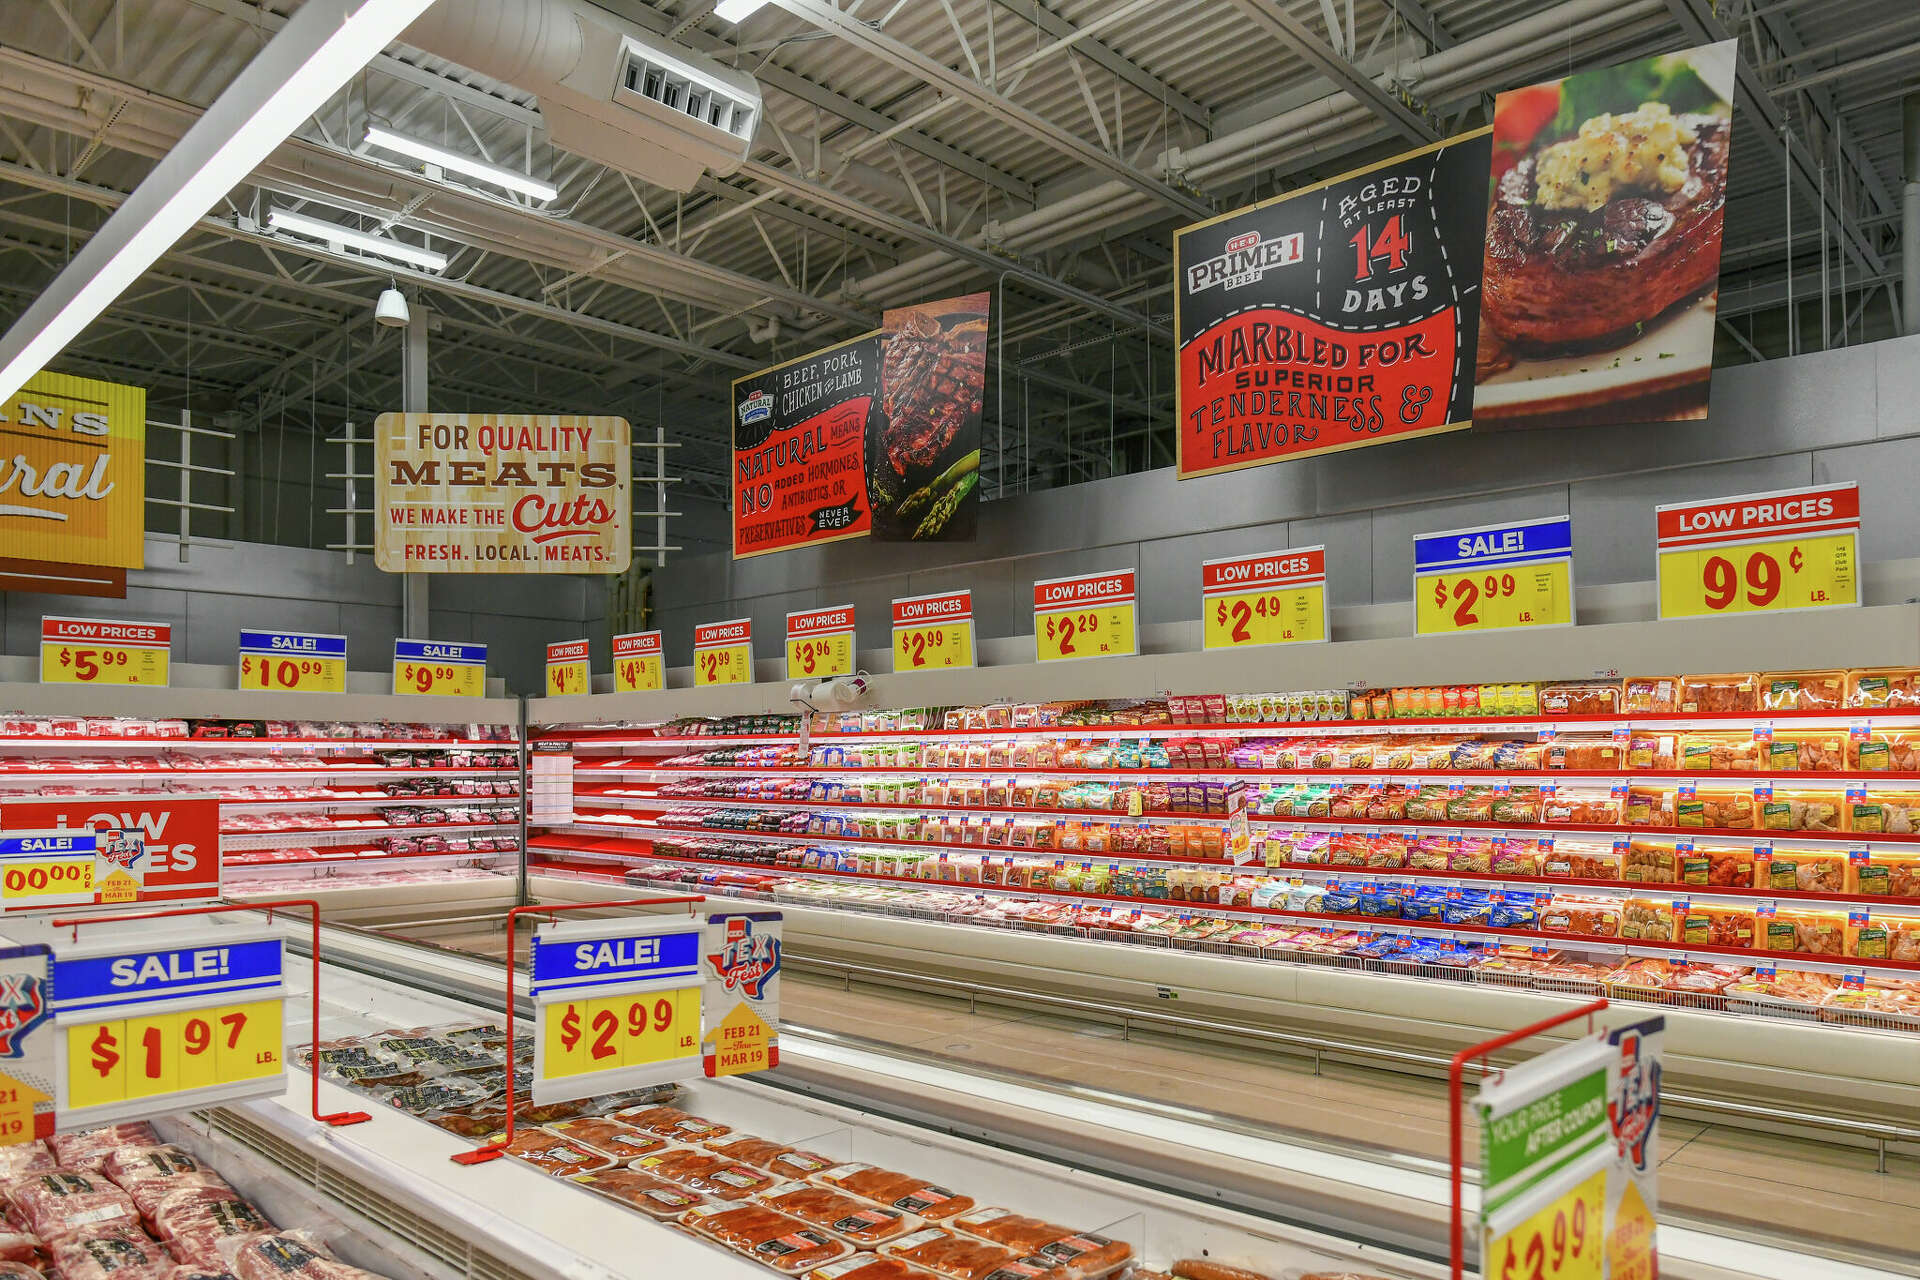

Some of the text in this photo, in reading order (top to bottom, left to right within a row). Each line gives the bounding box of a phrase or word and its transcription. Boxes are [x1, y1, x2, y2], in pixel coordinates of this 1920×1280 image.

[1338, 176, 1421, 219] AGED
[1344, 198, 1416, 228] AT LEAST
[1348, 214, 1412, 282] 14
[1190, 236, 1300, 290] PRIME 1
[1226, 271, 1262, 289] BEEF
[1341, 275, 1429, 313] DAYS
[1198, 322, 1437, 388] MARBLED FOR
[783, 350, 862, 389] BEEF, PORK,
[1235, 370, 1375, 393] SUPERIOR
[782, 381, 823, 416] CHICKEN
[835, 369, 862, 391] LAMB
[0, 402, 110, 436] NS
[1191, 384, 1433, 433] TENDERNESS &
[418, 424, 593, 456] FOR QUALITY
[738, 418, 860, 483] NATURAL MEANS
[1213, 423, 1319, 458] FLAVOR
[390, 460, 624, 490] MEATS,
[833, 479, 847, 496] OR
[742, 483, 774, 517] NO
[774, 473, 804, 489] ADDED
[390, 508, 415, 525] WE
[421, 508, 468, 525] MAKE
[473, 508, 505, 525] THE
[818, 507, 849, 519] NEVER
[818, 516, 850, 528] EVER
[1679, 497, 1834, 532] LOW PRICES
[739, 515, 806, 545] PRESERVATIVES
[405, 544, 610, 562] FRESH. LOCAL. MEATS.
[1457, 531, 1525, 557] SALE!
[1216, 557, 1310, 582] LOW PRICES
[1045, 579, 1123, 601] LOW PRICES
[795, 612, 847, 629] LOW PRICES
[901, 600, 962, 617] LOW PRICES
[58, 623, 156, 640] LOW PRICES
[271, 636, 317, 650] SALE!
[618, 637, 655, 650] LOW PRICES
[701, 625, 744, 640] LOW PRICES
[423, 645, 462, 658] SALE!
[551, 646, 584, 657] LOW PRICES
[20, 837, 73, 851] SALE!
[574, 938, 661, 970] SALE!
[722, 933, 772, 969] TEX
[110, 948, 231, 987] SALE!
[726, 959, 762, 989] Fest
[724, 1024, 761, 1040] FEB 21
[256, 1051, 277, 1064] LB.
[721, 1050, 763, 1067] MAR 19
